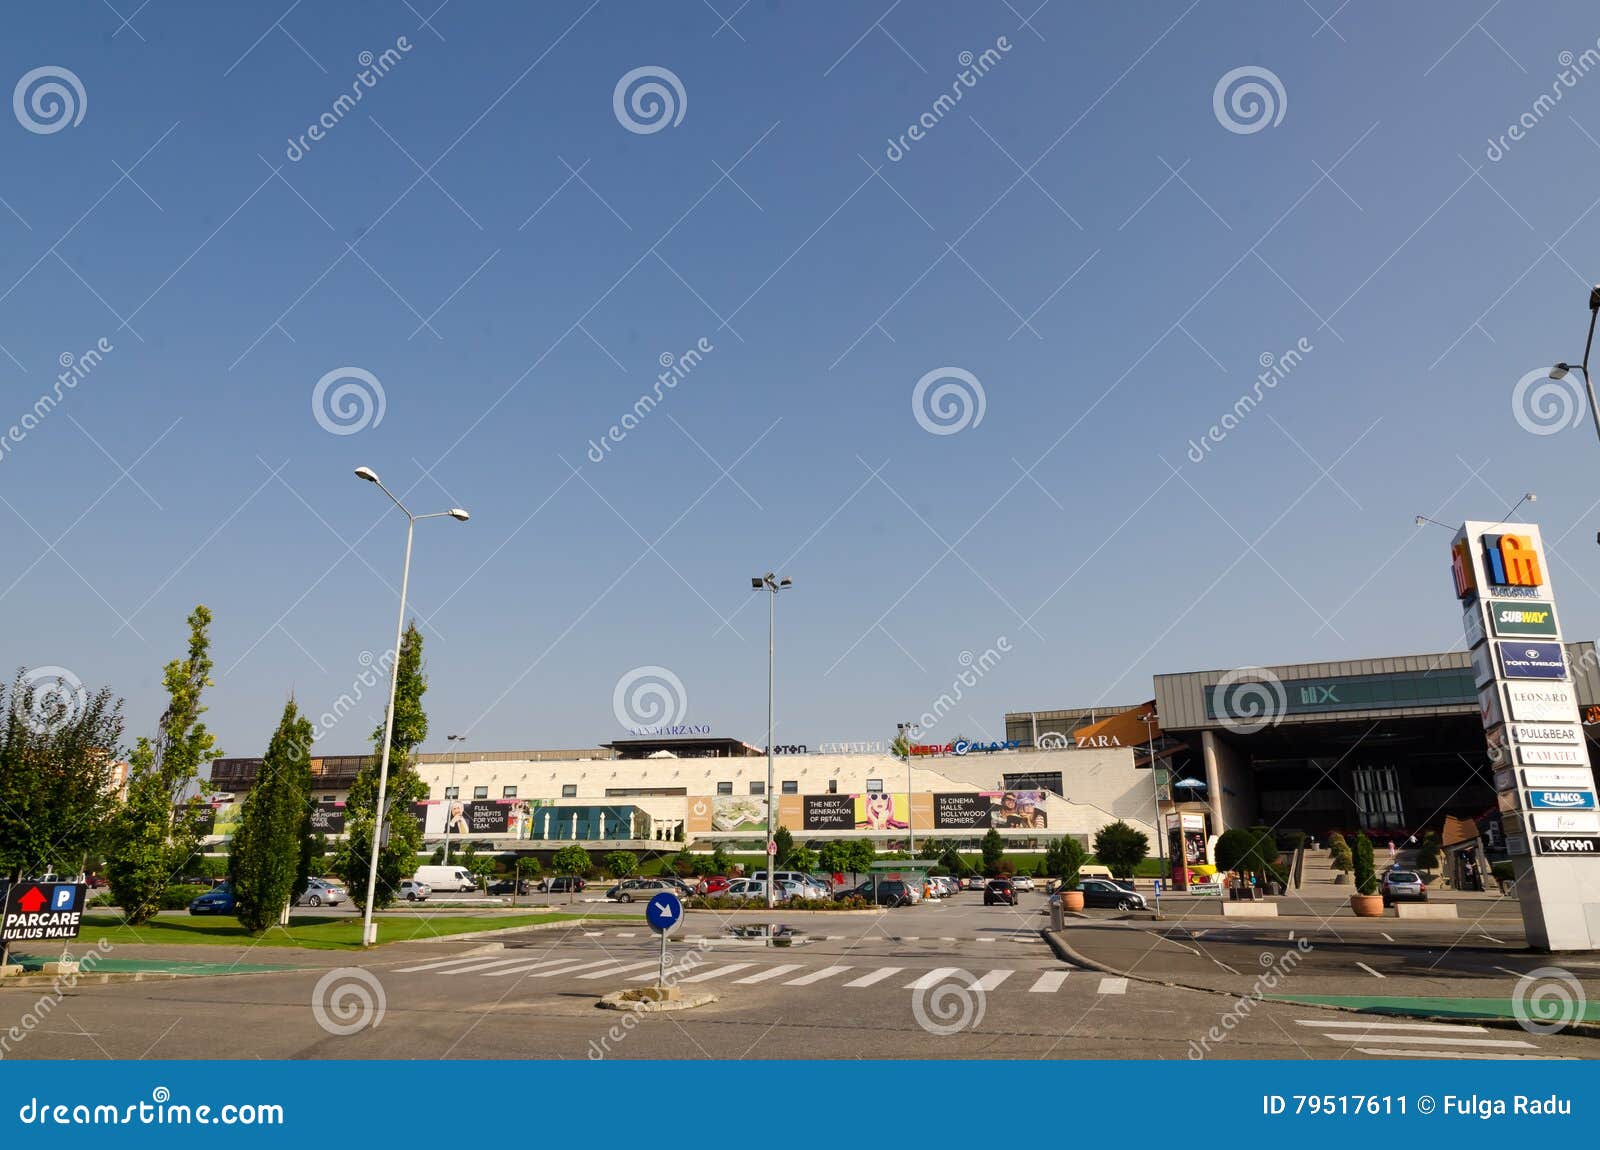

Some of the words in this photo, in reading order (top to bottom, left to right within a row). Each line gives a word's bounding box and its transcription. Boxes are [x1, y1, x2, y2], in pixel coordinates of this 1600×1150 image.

[1500, 611, 1548, 623] SUBWAY
[1514, 693, 1568, 702] LEONARD
[654, 725, 711, 736] MARZANO
[1520, 728, 1576, 740] PULL&BEAR
[1077, 735, 1121, 749] ZARA
[909, 743, 953, 756] MEDIA
[1543, 792, 1581, 802] FLANCO
[1550, 840, 1594, 851] KOTON
[57, 890, 70, 908] P
[6, 911, 81, 928] PARCARE
[2, 927, 43, 940] IULIUS
[45, 926, 77, 938] MALL
